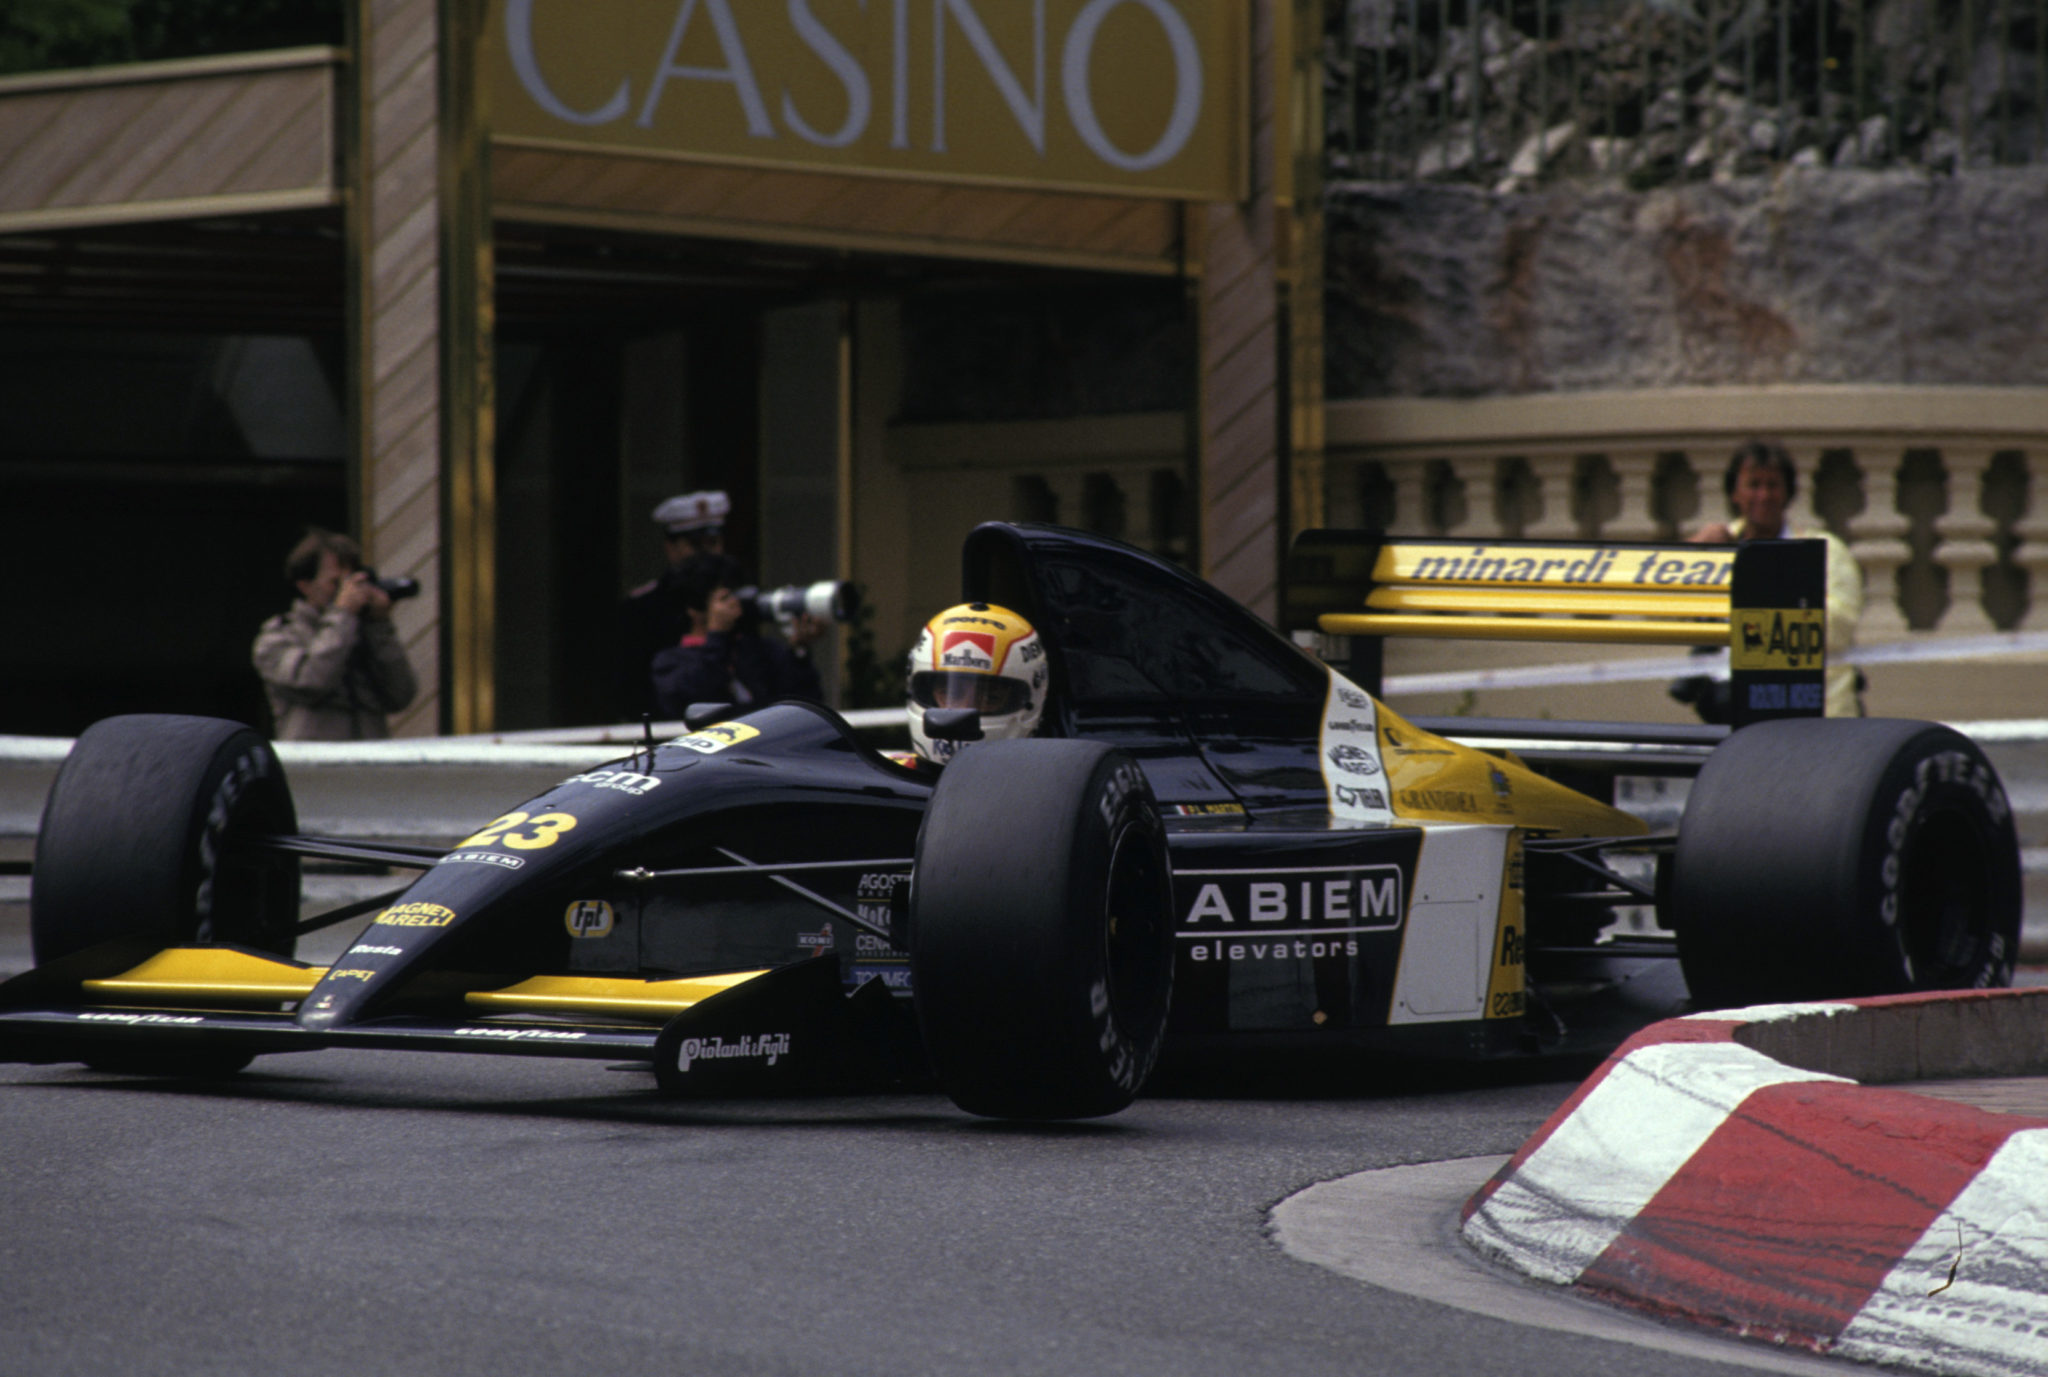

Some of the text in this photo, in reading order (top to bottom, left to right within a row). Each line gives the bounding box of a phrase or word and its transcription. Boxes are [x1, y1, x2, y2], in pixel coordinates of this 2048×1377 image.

[503, 0, 1203, 171] CASINO
[1411, 548, 1617, 583] minardi
[1766, 610, 1824, 667] Agip
[943, 650, 993, 671] Marlboro
[454, 811, 578, 850] 23
[1191, 940, 1358, 961] elevators
